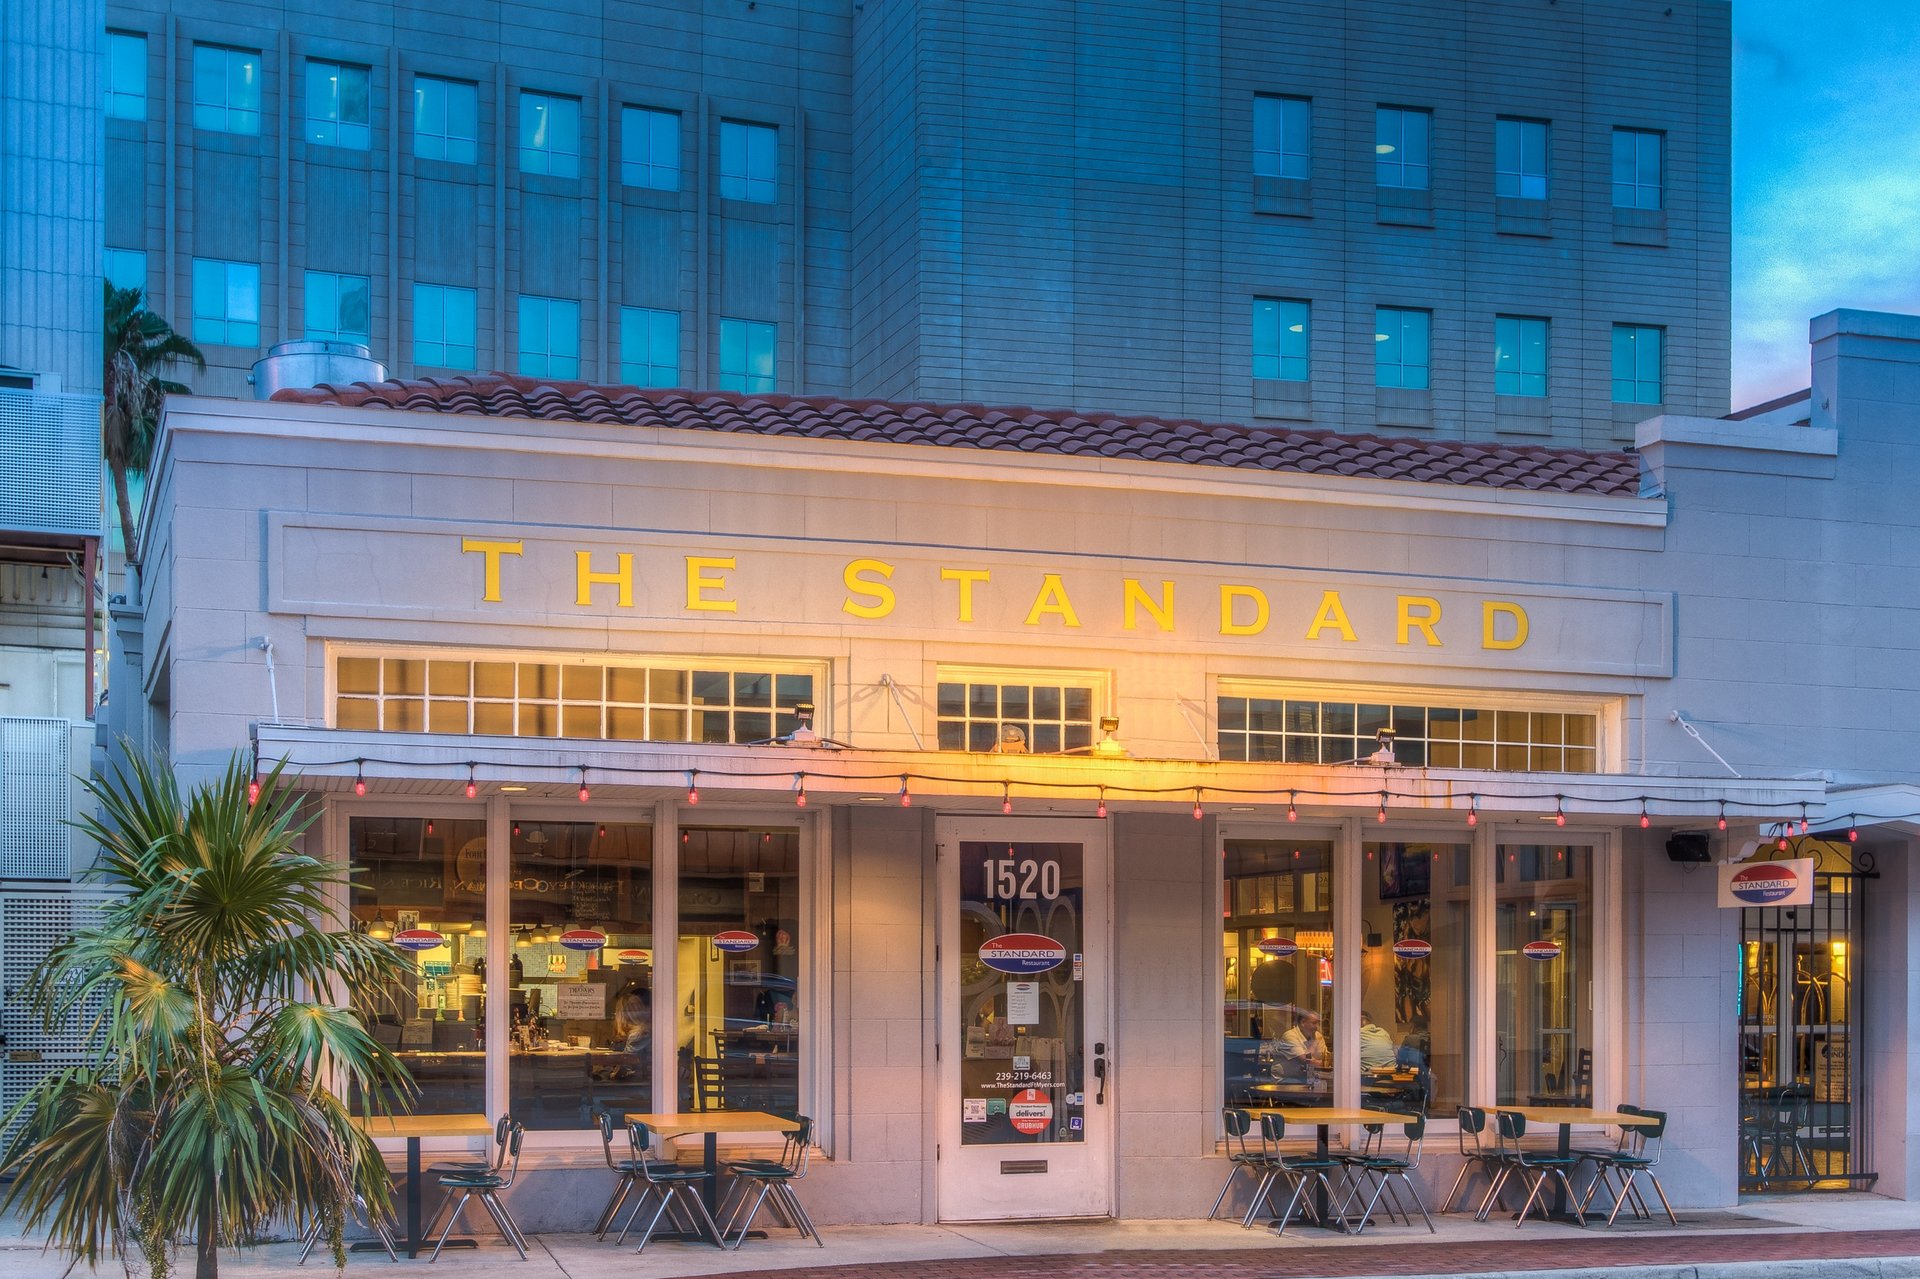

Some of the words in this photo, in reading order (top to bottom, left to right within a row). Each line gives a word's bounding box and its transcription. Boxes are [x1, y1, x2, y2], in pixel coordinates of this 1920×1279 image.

[462, 537, 737, 613] THE
[842, 559, 1529, 650] STANDARD
[984, 860, 1061, 900] 1520
[1739, 880, 1790, 890] STANDARD
[991, 950, 1055, 958] STANDARD
[996, 1071, 1052, 1081] 239-219-6463
[981, 1081, 1066, 1089] www.TheStandardFtMyers.com
